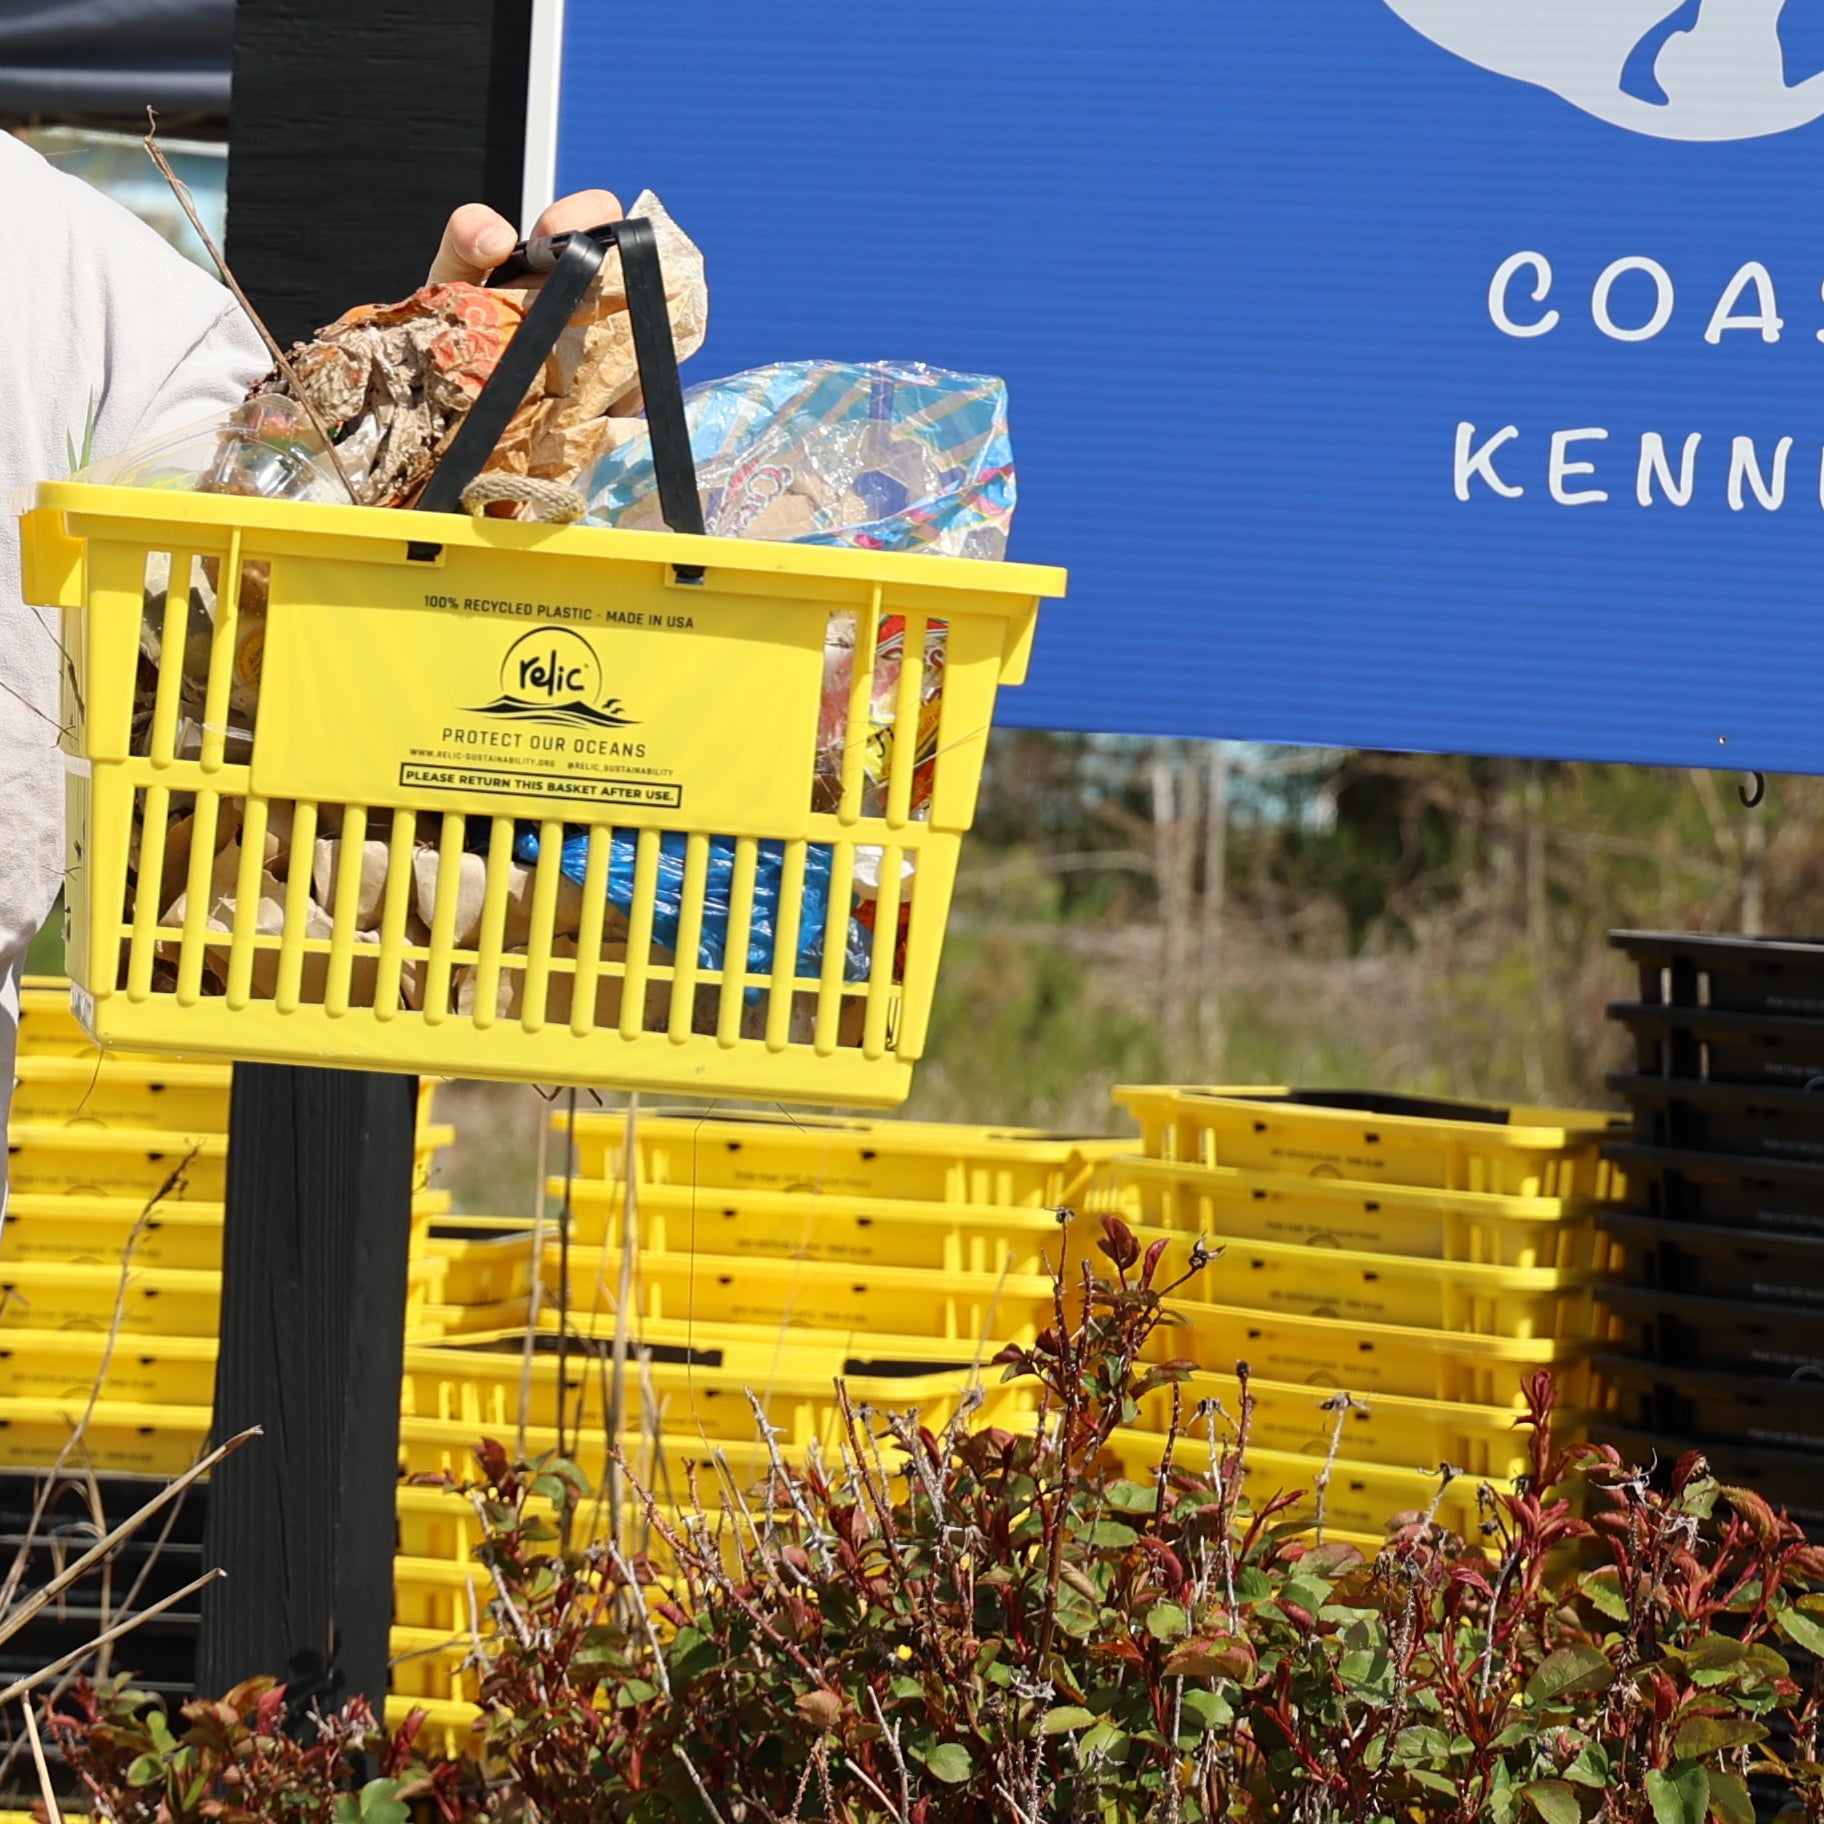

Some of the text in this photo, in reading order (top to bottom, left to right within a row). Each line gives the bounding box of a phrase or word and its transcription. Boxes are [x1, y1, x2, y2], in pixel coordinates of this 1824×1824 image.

[424, 595, 459, 610] 100%
[464, 598, 533, 616] RECYCLED
[537, 605, 592, 621] PLASTIC
[606, 610, 644, 625] MADE
[649, 614, 662, 626] IN
[667, 615, 694, 629] USA
[520, 650, 584, 697] relic
[409, 749, 556, 768] WWW.RELIC-SUSTAINABILITY.ORG
[442, 728, 646, 758] PROTECT OUR OCEANS
[406, 771, 674, 802] PLEASE RETURN THIS BASKET AFTER USE.
